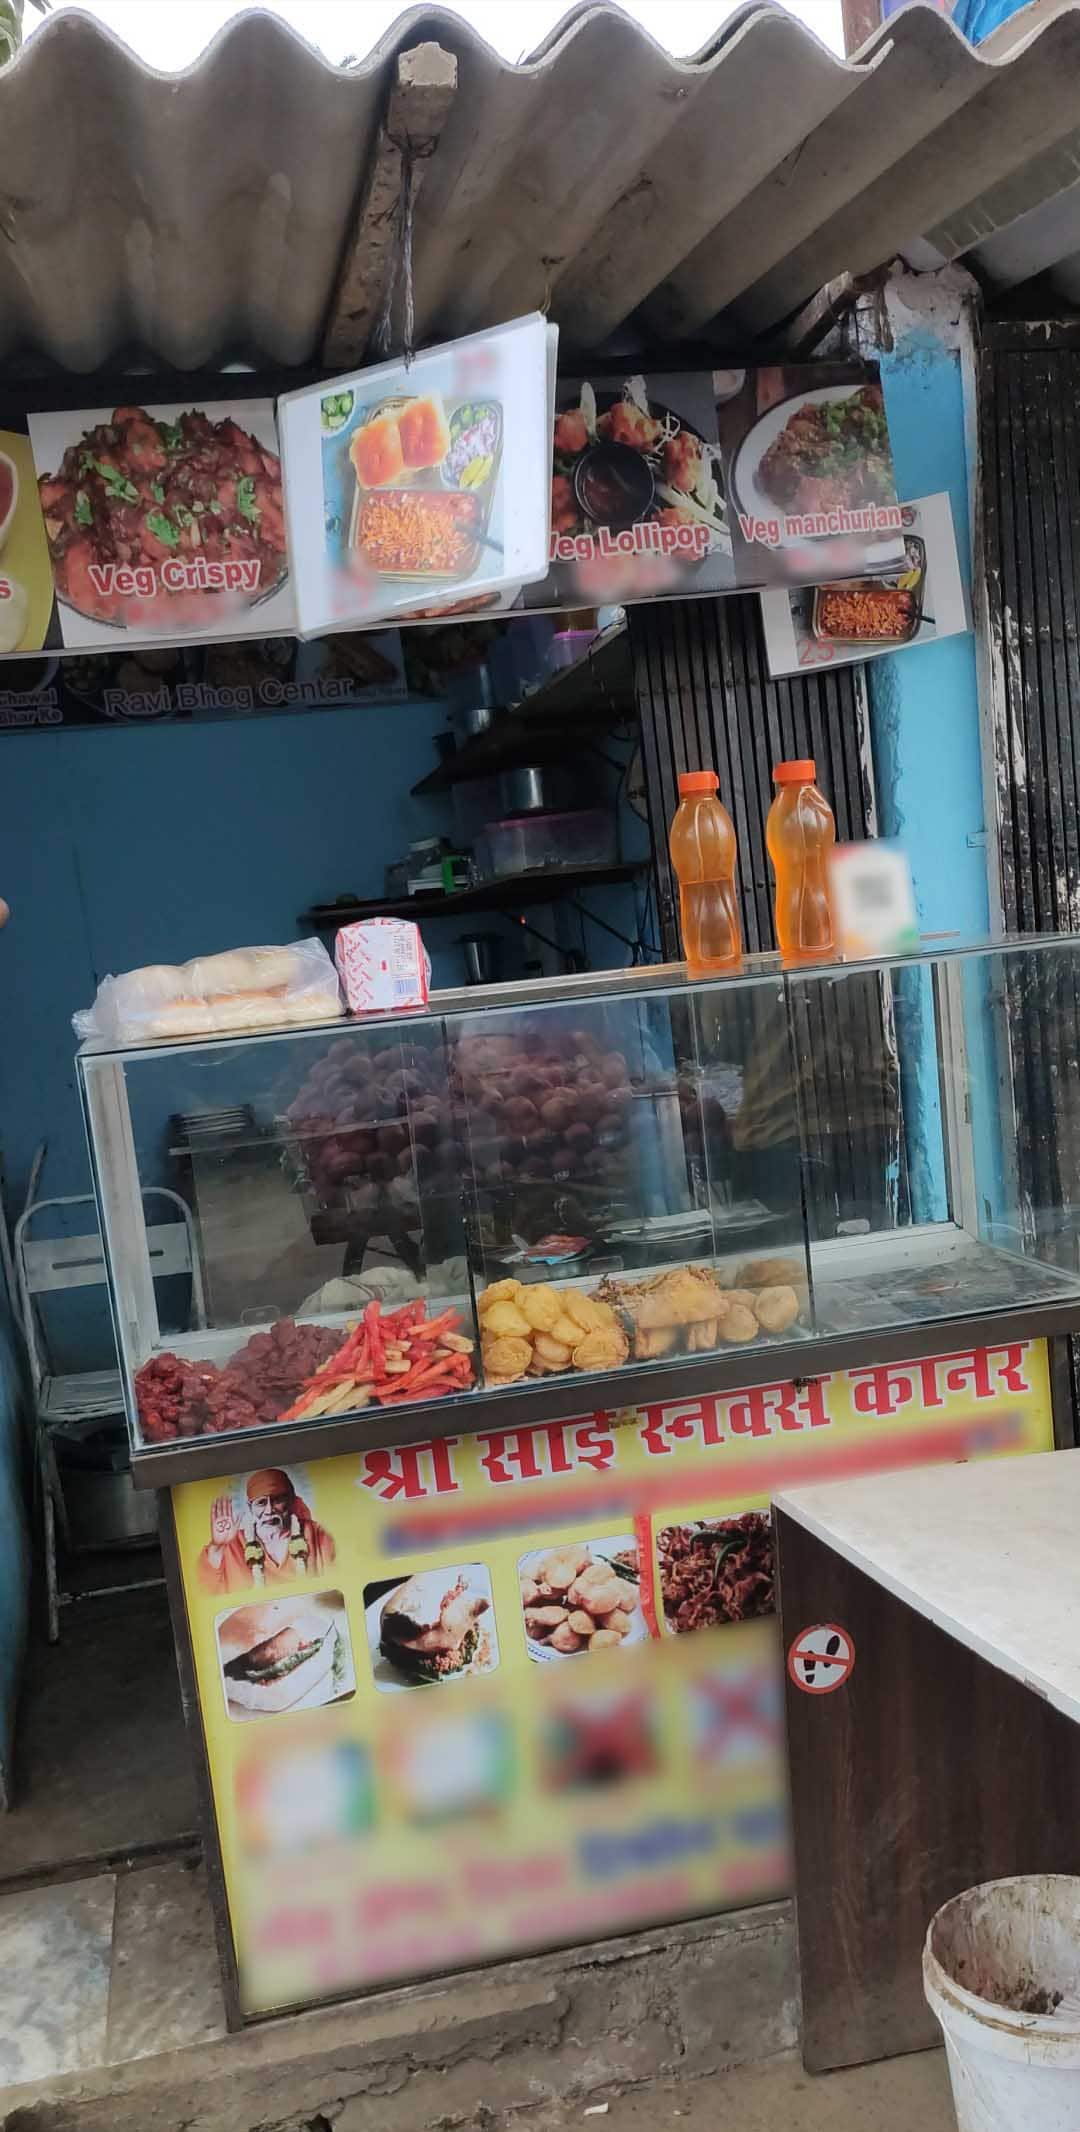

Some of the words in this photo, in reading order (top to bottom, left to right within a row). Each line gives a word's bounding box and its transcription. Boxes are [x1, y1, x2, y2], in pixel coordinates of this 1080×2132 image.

[599, 522, 711, 559] Lollipop
[740, 513, 781, 546] Veg
[785, 502, 901, 537] manchurian
[89, 564, 156, 597] Veg
[161, 557, 261, 590] Crispy
[103, 685, 172, 716] Ravi
[176, 682, 252, 712] Bhog
[259, 676, 355, 705] Centar
